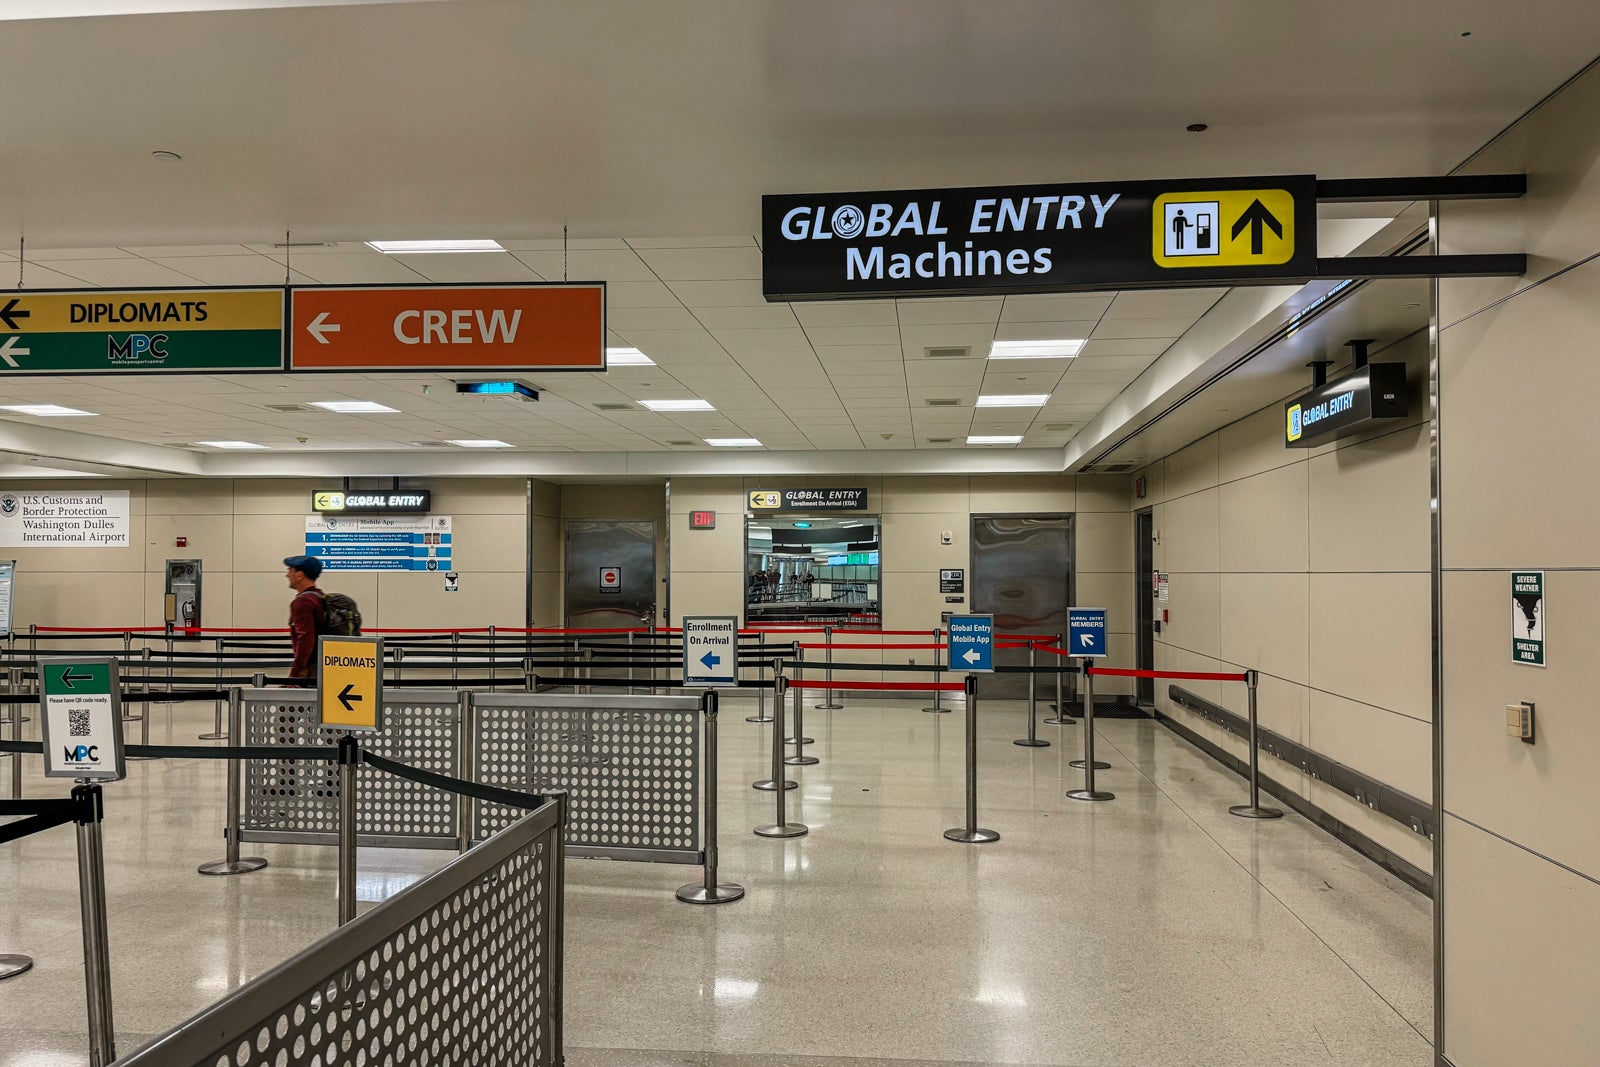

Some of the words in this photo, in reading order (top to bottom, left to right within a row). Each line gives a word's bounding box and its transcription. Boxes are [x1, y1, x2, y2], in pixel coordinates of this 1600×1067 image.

[780, 201, 949, 241] GLOBAL
[969, 193, 1121, 234] ENTRY
[846, 241, 1053, 281] Machines
[70, 301, 208, 323] DIPLOMATS
[393, 309, 523, 345] CREW
[107, 333, 169, 360] MPC
[1302, 401, 1329, 427] GLOBAL
[1329, 390, 1354, 416] ENTRY
[22, 495, 41, 505] U.S.
[42, 495, 84, 505] Customs
[85, 495, 103, 505] and
[785, 490, 824, 500] GLOBAL
[828, 490, 862, 499] ENTRY
[345, 495, 386, 506] GLOBAL
[388, 495, 424, 506] ENTRY
[22, 506, 55, 516] Border
[58, 506, 108, 516] Protection
[22, 519, 80, 532] Washington
[84, 519, 115, 529] Dulles
[22, 531, 86, 542] International
[89, 531, 126, 544] Airport
[321, 547, 329, 555] 2.
[321, 560, 329, 568] 3.
[1516, 575, 1537, 583] SEVERE
[1515, 584, 1539, 592] WEATHER
[687, 622, 732, 632] Enrollment
[951, 624, 973, 632] Global
[973, 624, 991, 634] Entry
[689, 636, 701, 645] On
[702, 636, 729, 645] Arrival
[952, 635, 975, 643] Mobile
[976, 635, 990, 645] App
[1516, 642, 1539, 652] SHELTER
[1520, 651, 1535, 660] AREA
[324, 655, 376, 668] DIPLOMATS
[63, 744, 99, 762] MPC
